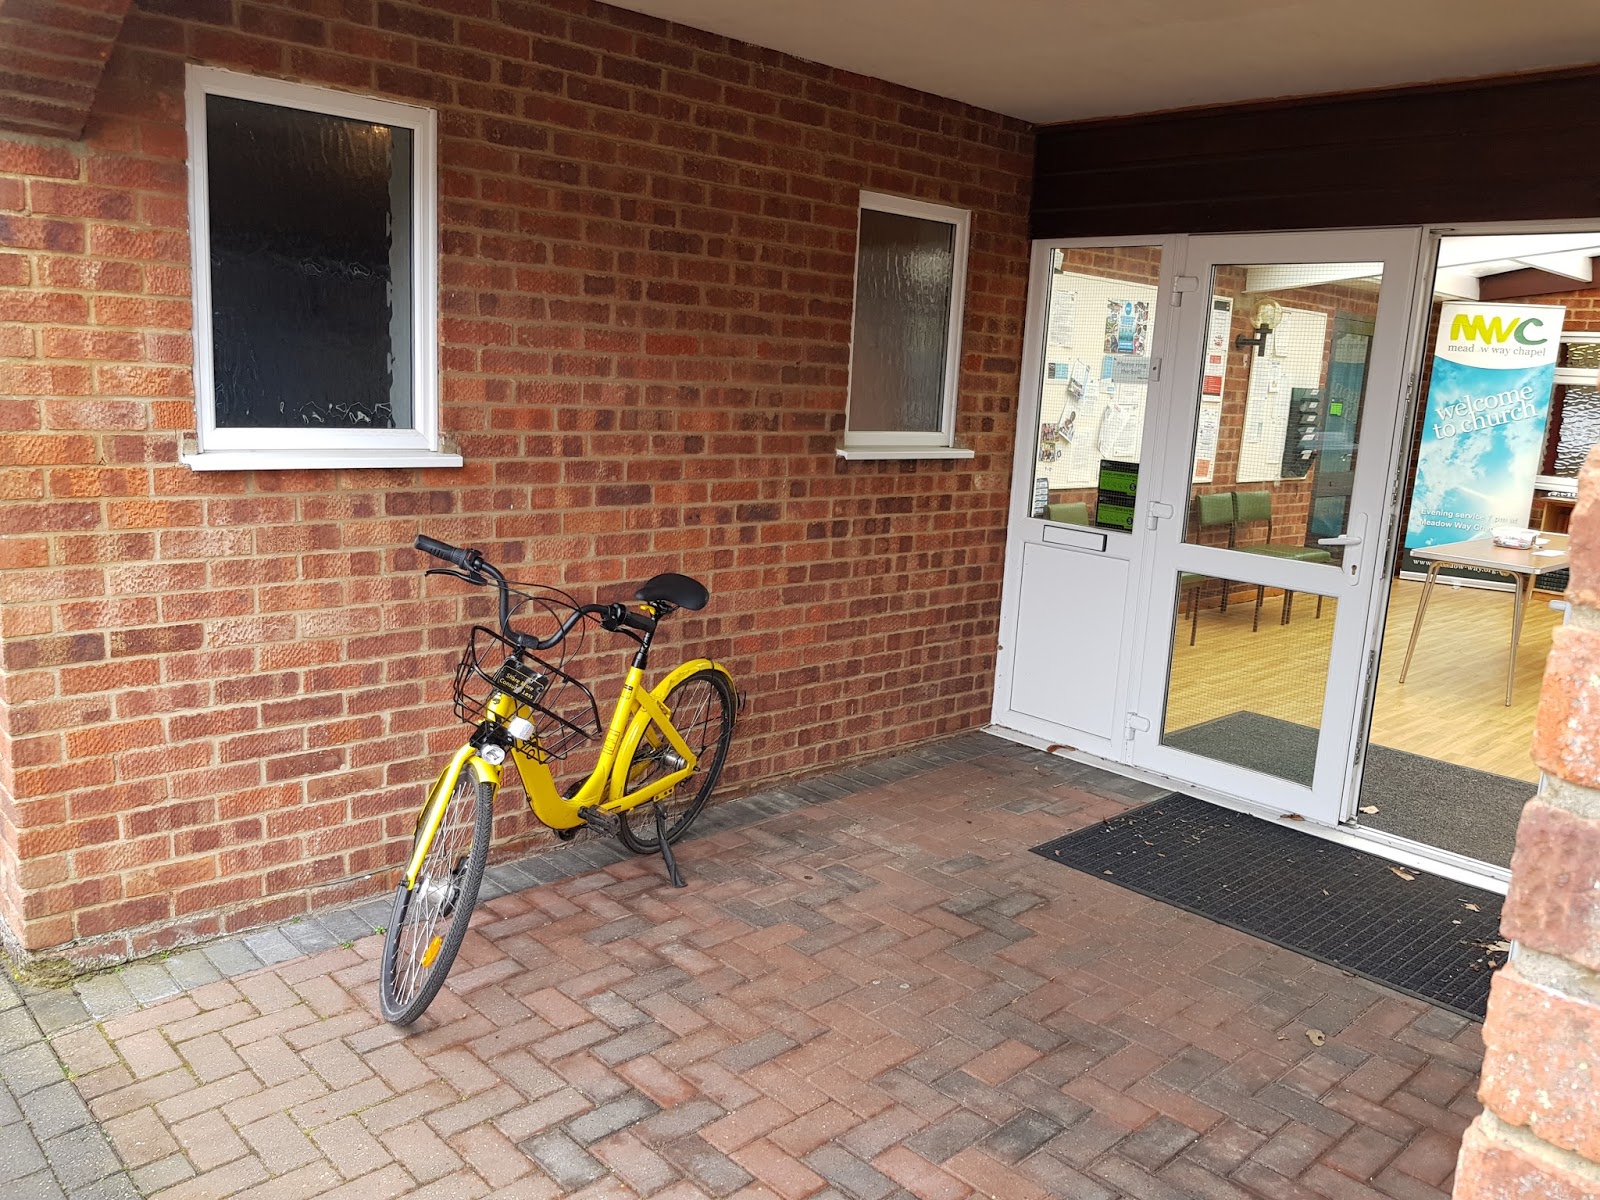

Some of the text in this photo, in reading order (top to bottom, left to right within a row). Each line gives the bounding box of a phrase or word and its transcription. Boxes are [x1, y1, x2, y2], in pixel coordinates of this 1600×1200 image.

[1491, 347, 1511, 356] way
[1513, 347, 1546, 357] chapel
[1435, 385, 1534, 421] welcome
[1432, 400, 1539, 440] to church
[1421, 508, 1454, 519] Evening
[1455, 512, 1486, 521] service
[1420, 518, 1453, 530] Meadow
[1454, 522, 1472, 532] Way
[506, 672, 520, 685] Share
